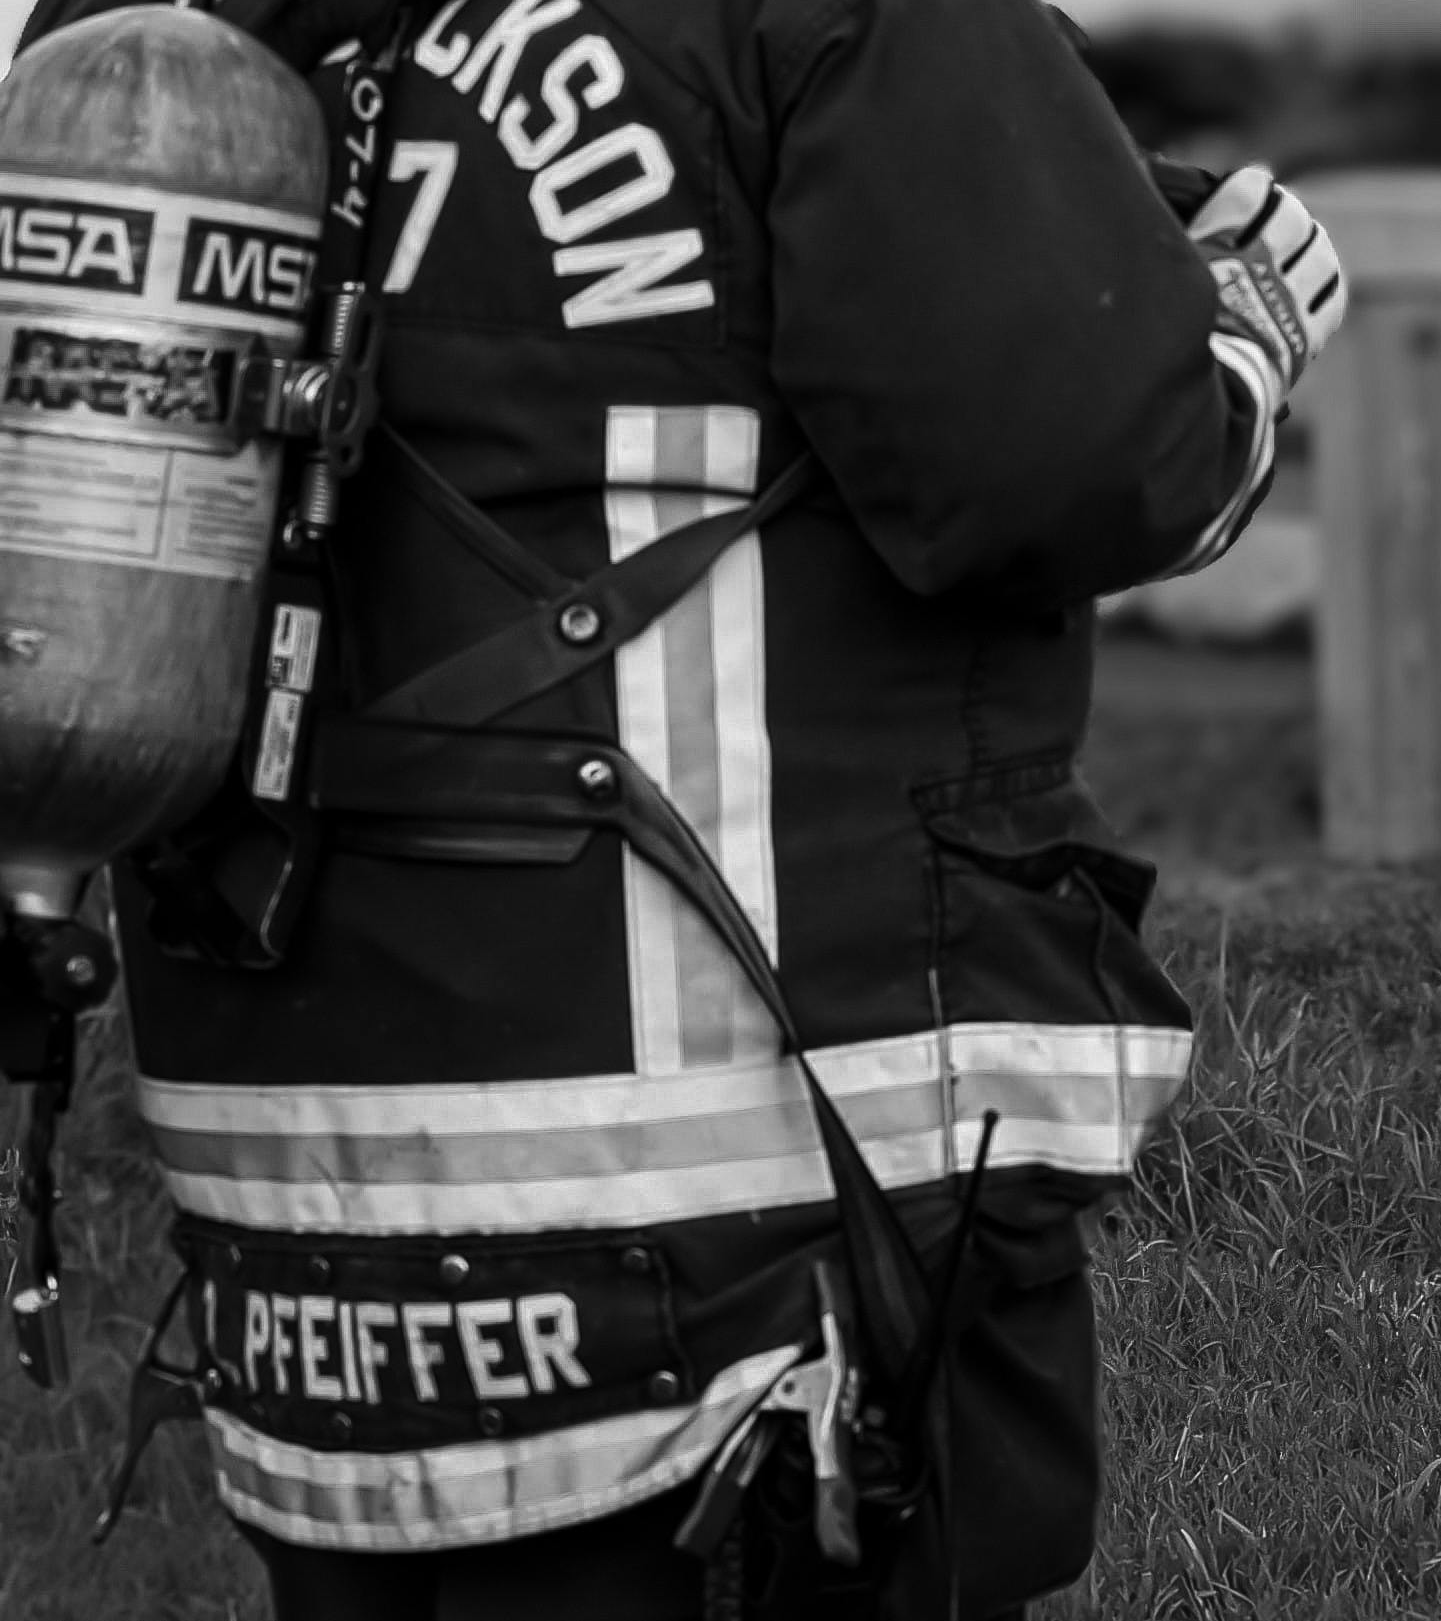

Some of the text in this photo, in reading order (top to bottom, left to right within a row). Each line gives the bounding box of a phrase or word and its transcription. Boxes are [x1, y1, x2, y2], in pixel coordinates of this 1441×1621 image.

[192, 232, 316, 309] MS
[381, 138, 459, 294] 7
[244, 1289, 591, 1405] PFEIFFER
